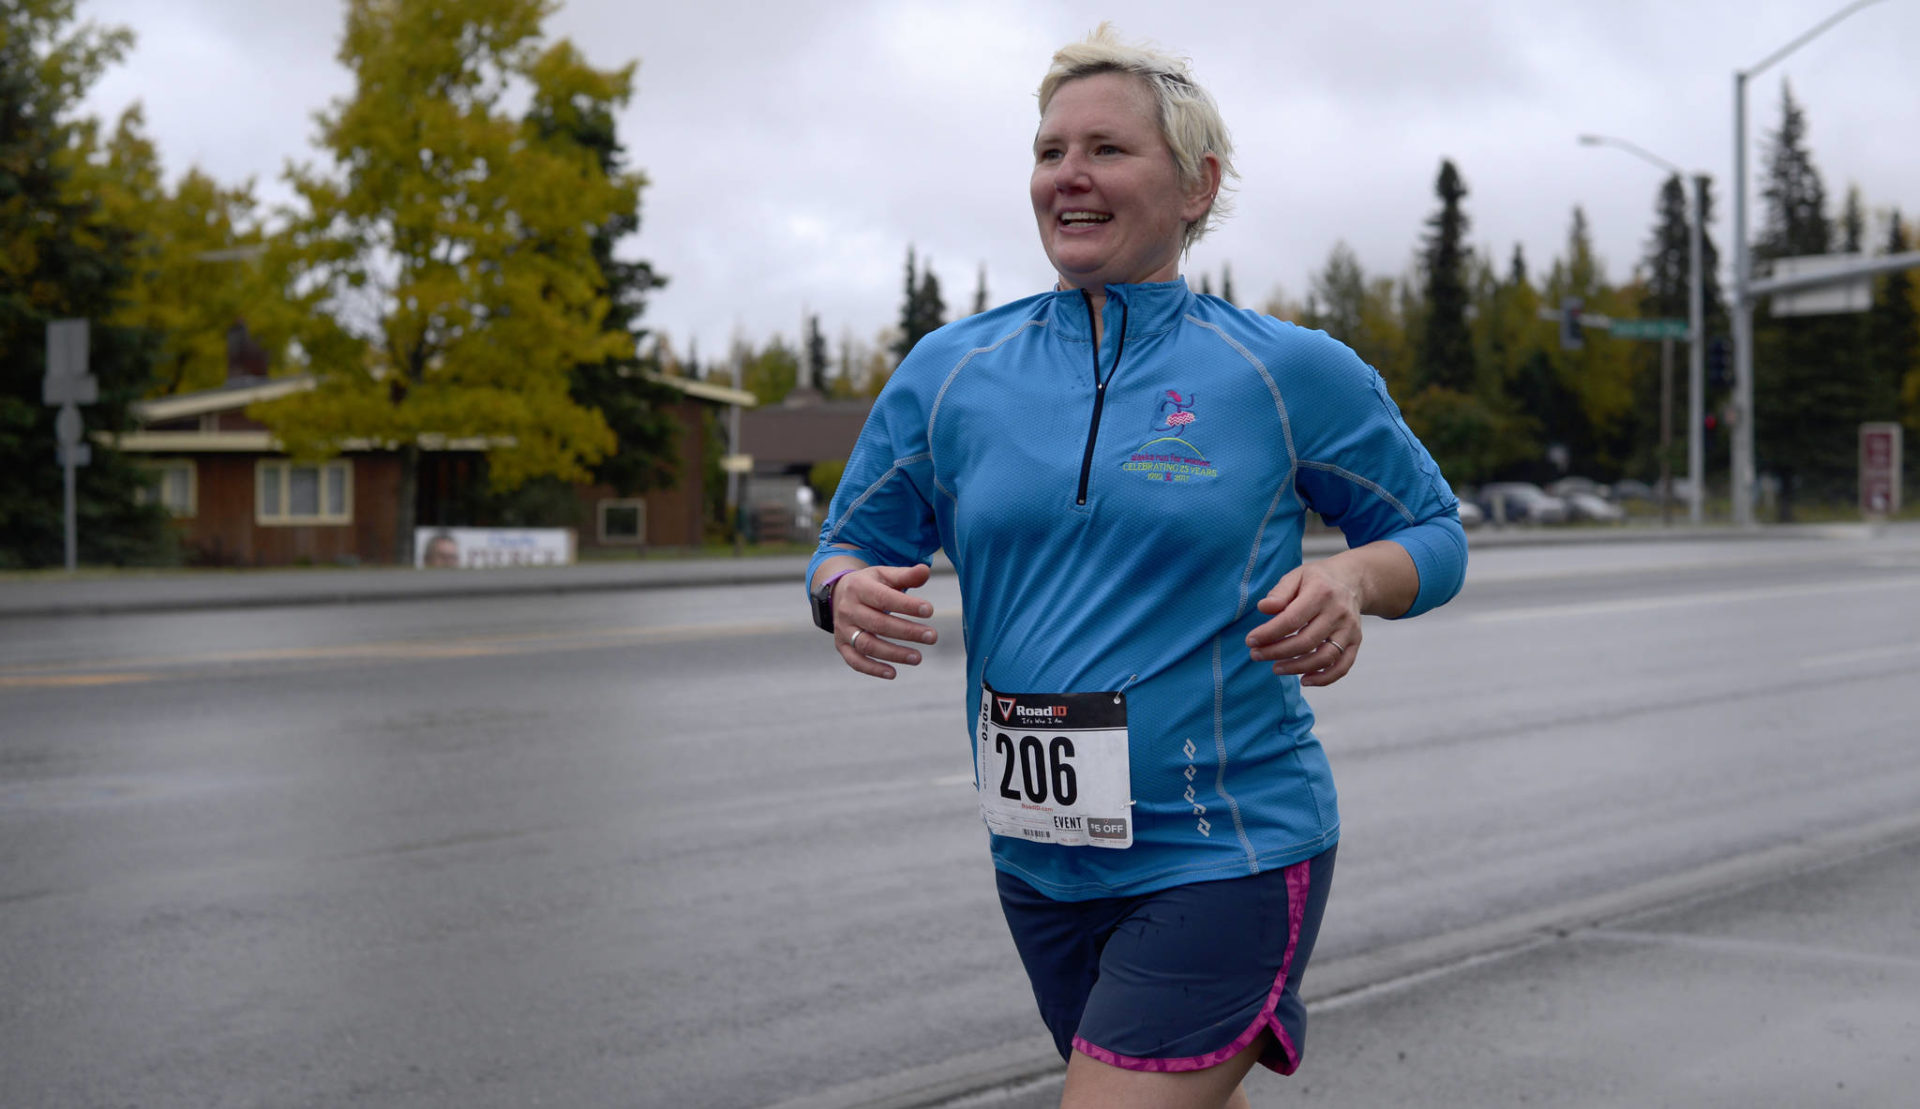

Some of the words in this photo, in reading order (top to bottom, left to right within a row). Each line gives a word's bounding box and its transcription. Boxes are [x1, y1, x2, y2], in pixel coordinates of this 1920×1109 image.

[1122, 462, 1179, 472] CELEBRATING
[1180, 464, 1190, 473] 25
[1191, 467, 1218, 478] YEARS
[981, 703, 989, 741] 0206
[995, 732, 1078, 807] 206
[1054, 815, 1082, 829] EVENT
[1103, 824, 1124, 833] OFF
